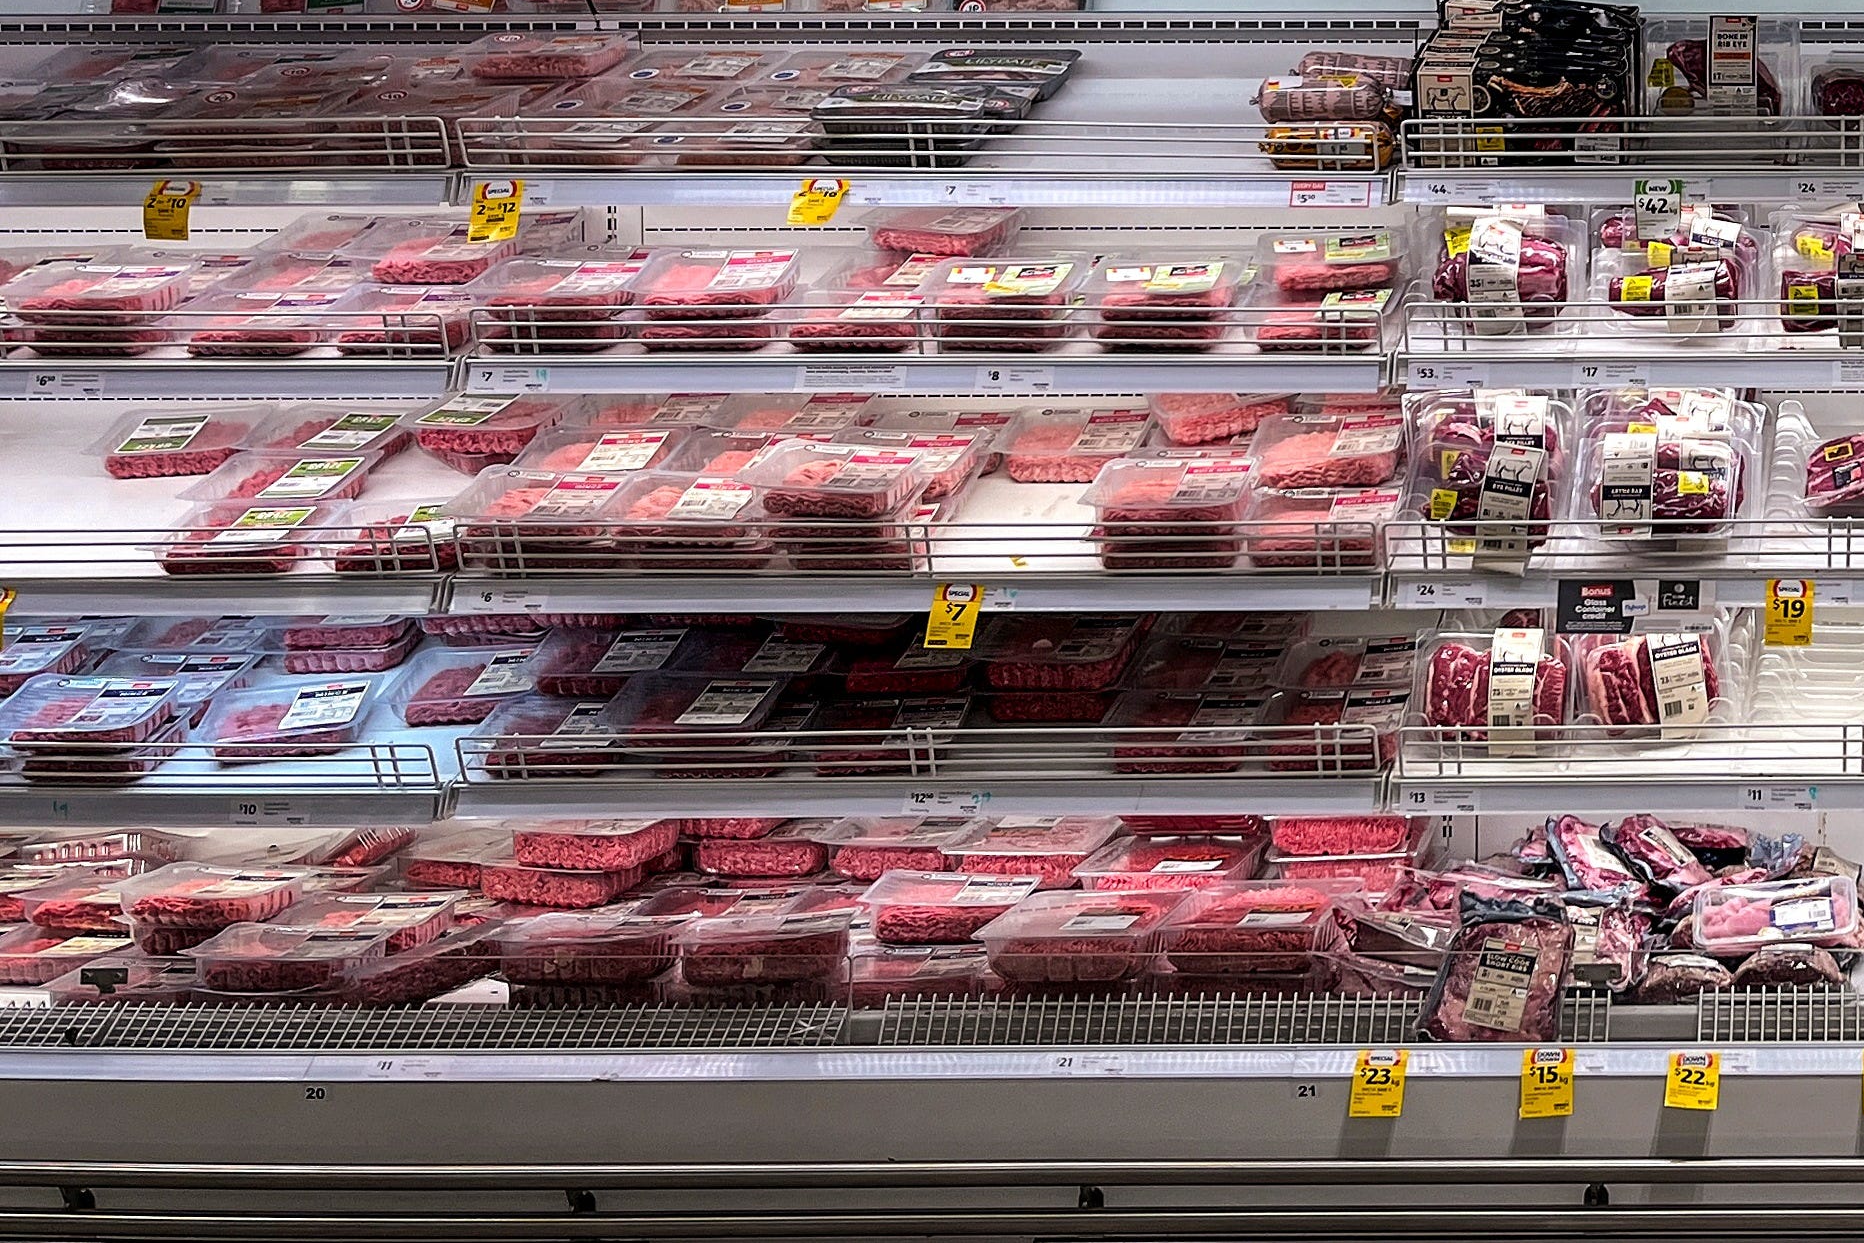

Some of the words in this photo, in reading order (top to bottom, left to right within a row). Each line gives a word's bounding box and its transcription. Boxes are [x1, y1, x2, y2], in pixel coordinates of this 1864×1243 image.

[945, 185, 956, 195] $7
[1798, 183, 1816, 193] $24
[147, 198, 156, 209] 2
[167, 197, 187, 209] $10
[476, 204, 486, 215] 2
[498, 202, 516, 213] $12
[1638, 198, 1669, 214] $42
[481, 371, 493, 382] $7
[988, 370, 999, 381] $8
[1417, 367, 1434, 378] $53
[1582, 366, 1598, 377] $17
[1416, 584, 1435, 596] $24
[1582, 586, 1612, 597] Bonus
[481, 592, 493, 603] $6
[1584, 598, 1607, 606] Glass
[944, 602, 967, 621] $7
[1575, 605, 1616, 613] Container
[1772, 598, 1806, 619] $19
[1582, 612, 1606, 620] credit
[1654, 649, 1677, 660] OYSTER
[1678, 646, 1697, 656] BLADE
[1409, 792, 1426, 804] $13
[1747, 789, 1762, 801] $11
[239, 804, 257, 816] $10
[1360, 1067, 1392, 1085] $23
[1391, 1078, 1400, 1088] kg
[1529, 1066, 1559, 1084] $15
[1559, 1075, 1569, 1085] kg
[1675, 1067, 1706, 1086] $22
[1706, 1079, 1715, 1088] kg
[305, 1087, 326, 1100] 20
[1297, 1085, 1316, 1098] 21
